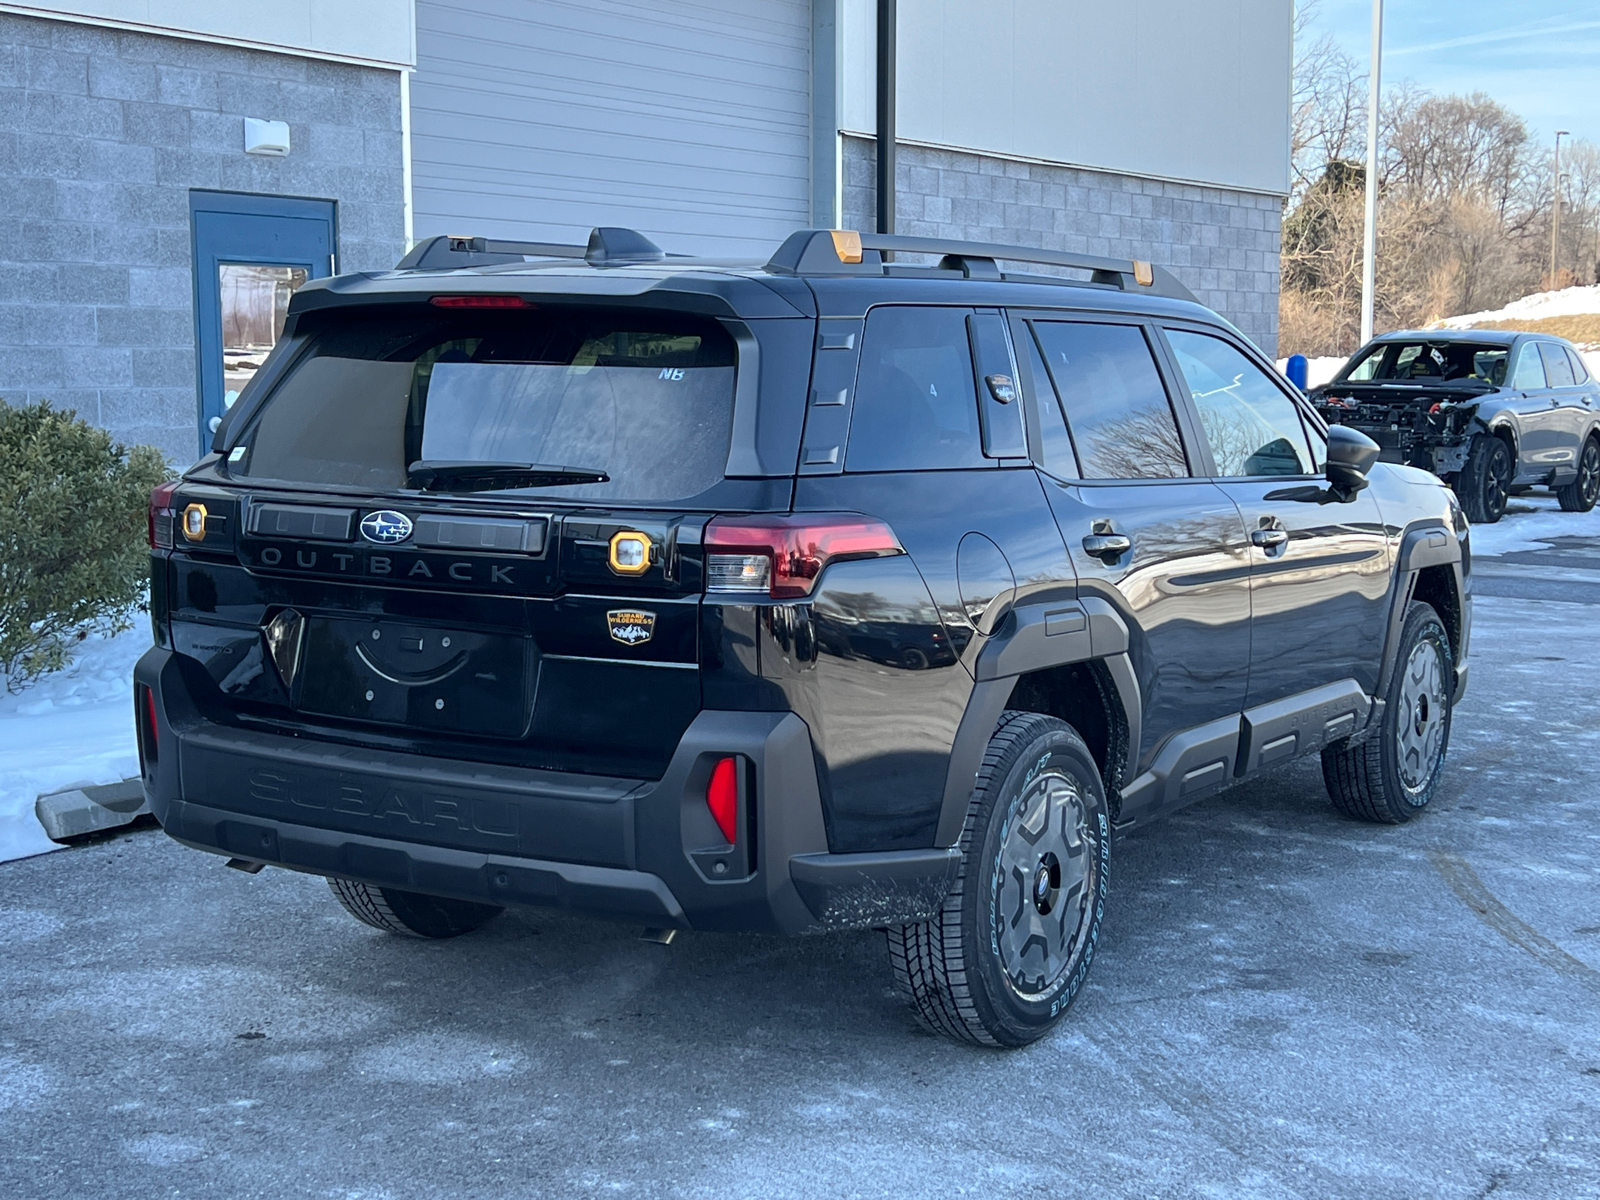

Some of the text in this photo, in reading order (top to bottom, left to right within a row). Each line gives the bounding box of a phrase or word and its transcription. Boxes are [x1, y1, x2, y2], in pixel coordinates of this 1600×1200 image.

[260, 548, 515, 584] OUTBACK
[609, 617, 653, 625] WILDERNESS
[1291, 698, 1357, 729] OUTBACK
[250, 772, 520, 838] SUBARU
